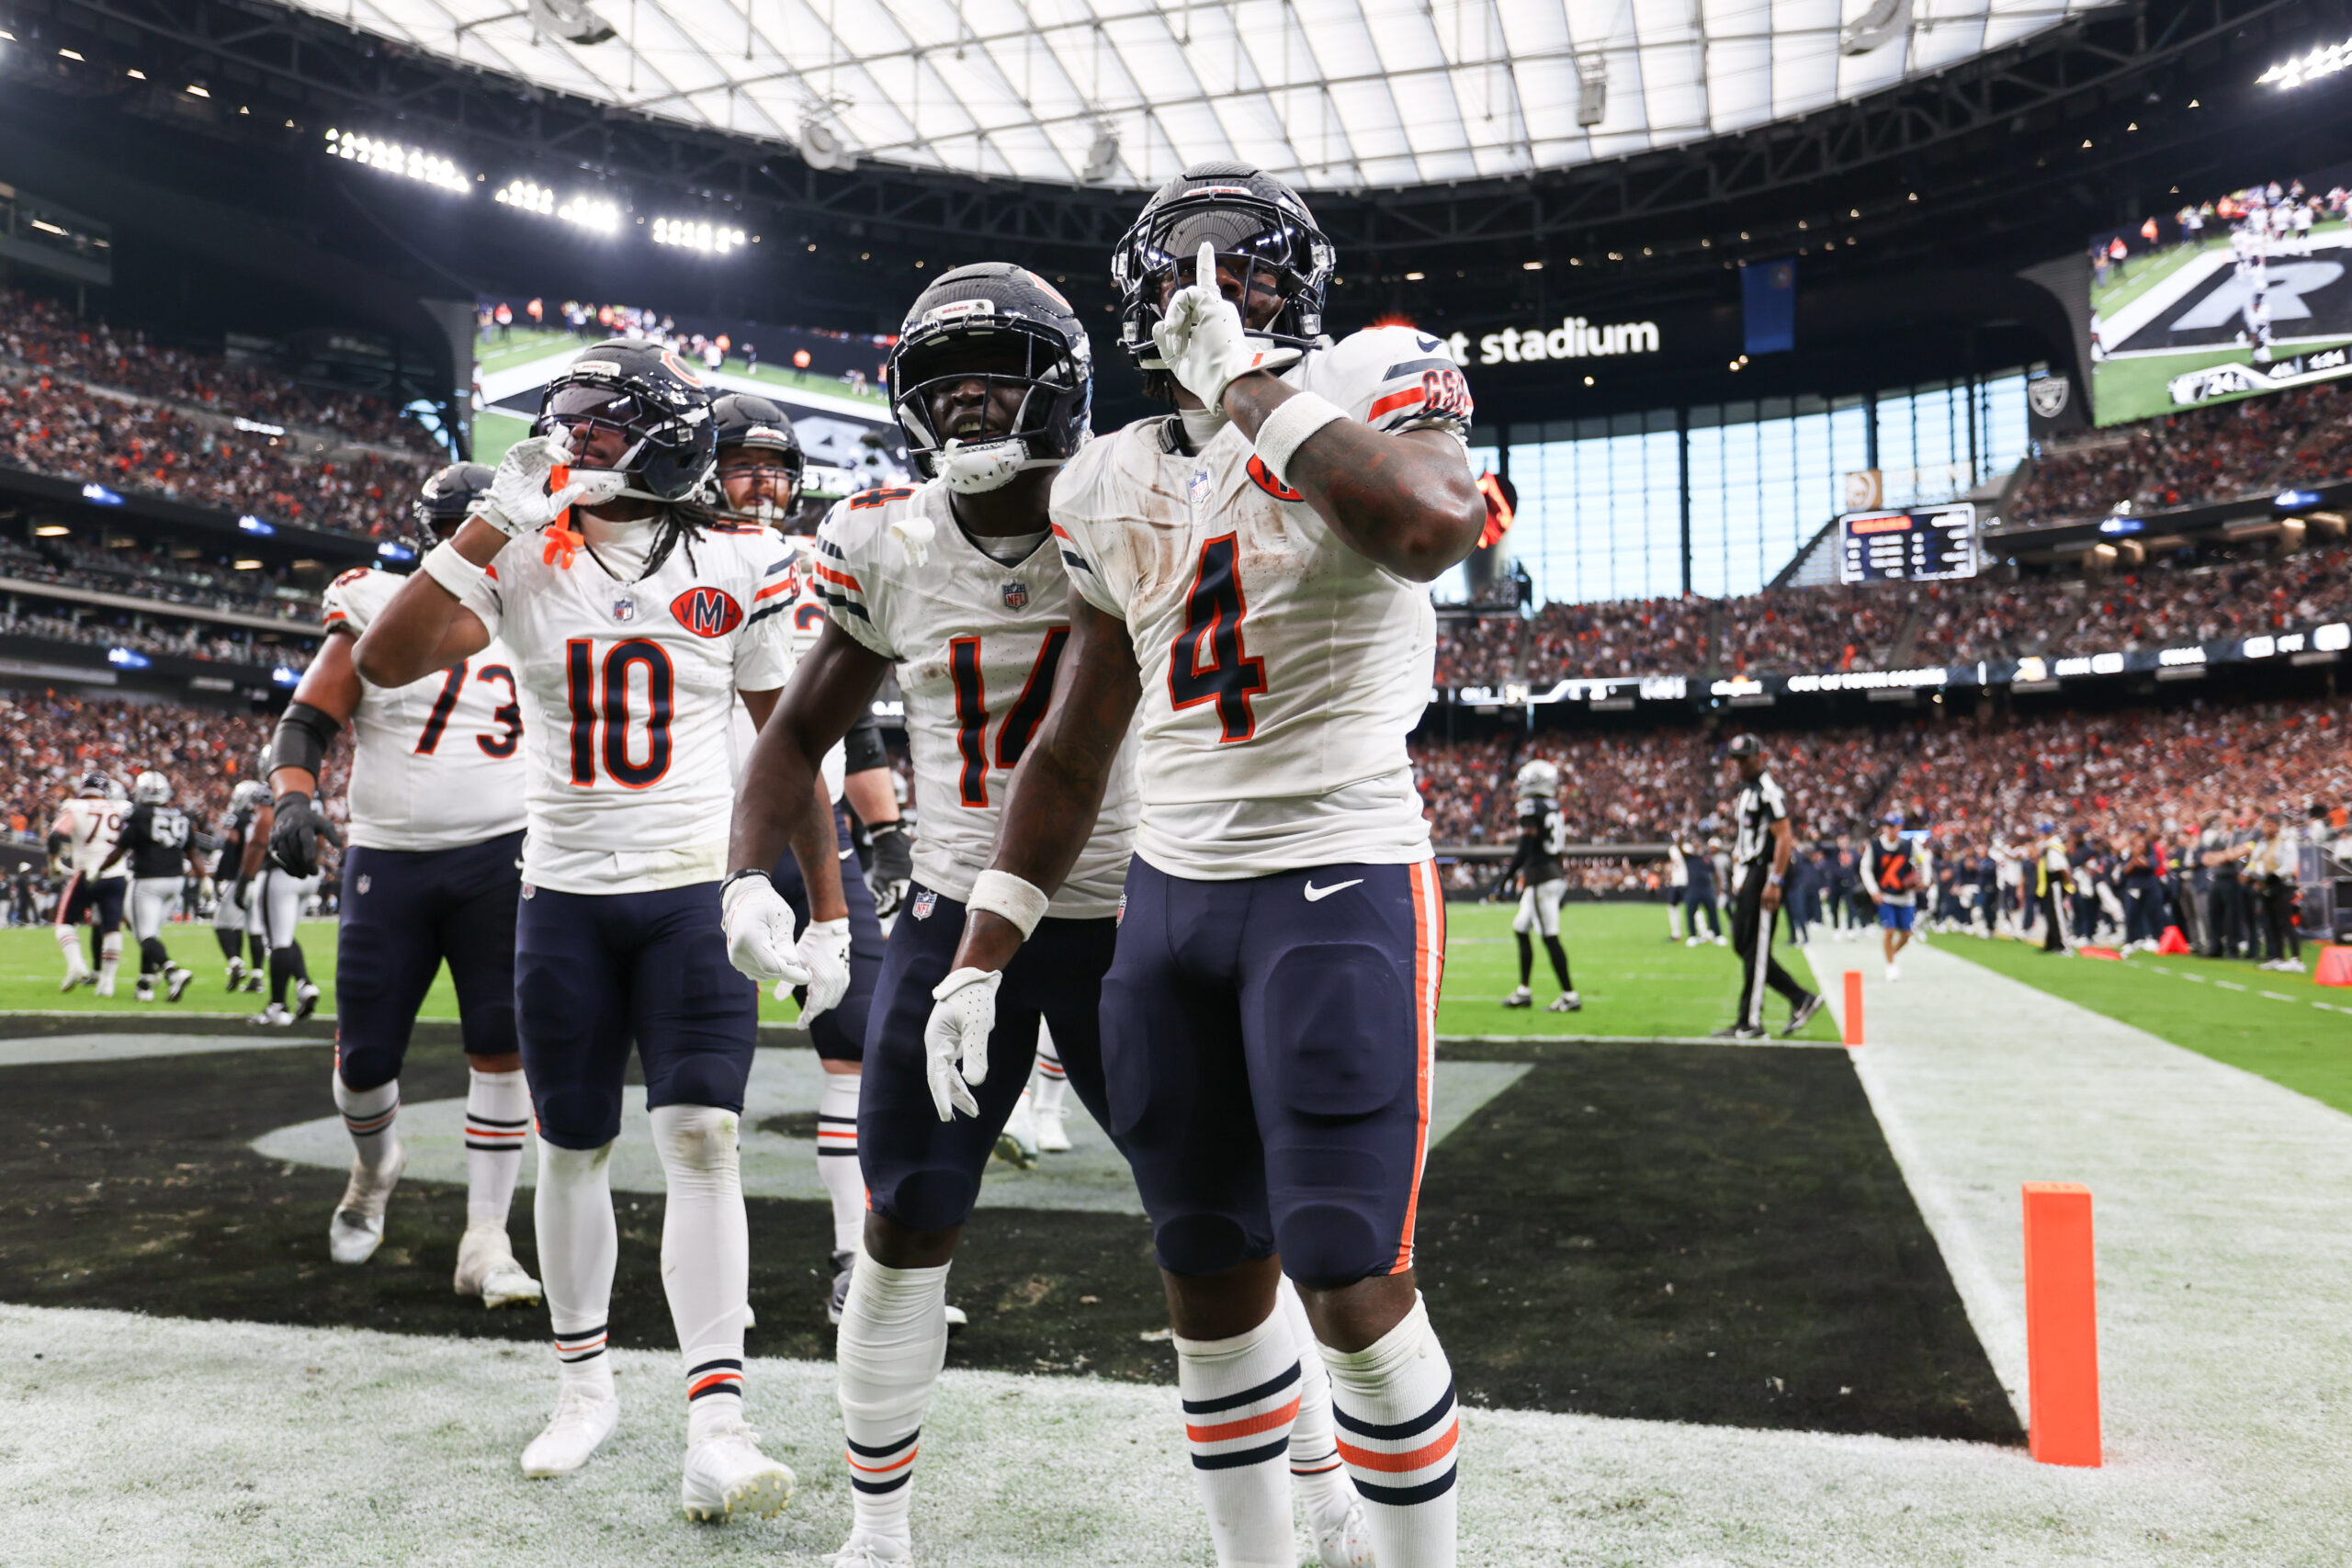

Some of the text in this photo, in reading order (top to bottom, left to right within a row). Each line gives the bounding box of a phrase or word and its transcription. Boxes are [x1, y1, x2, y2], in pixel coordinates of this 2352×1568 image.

[1480, 316, 1660, 366] stadium
[1007, 593, 1026, 606] NFL
[1168, 530, 1268, 744] 4
[414, 659, 526, 760] 73
[567, 637, 674, 790] 10
